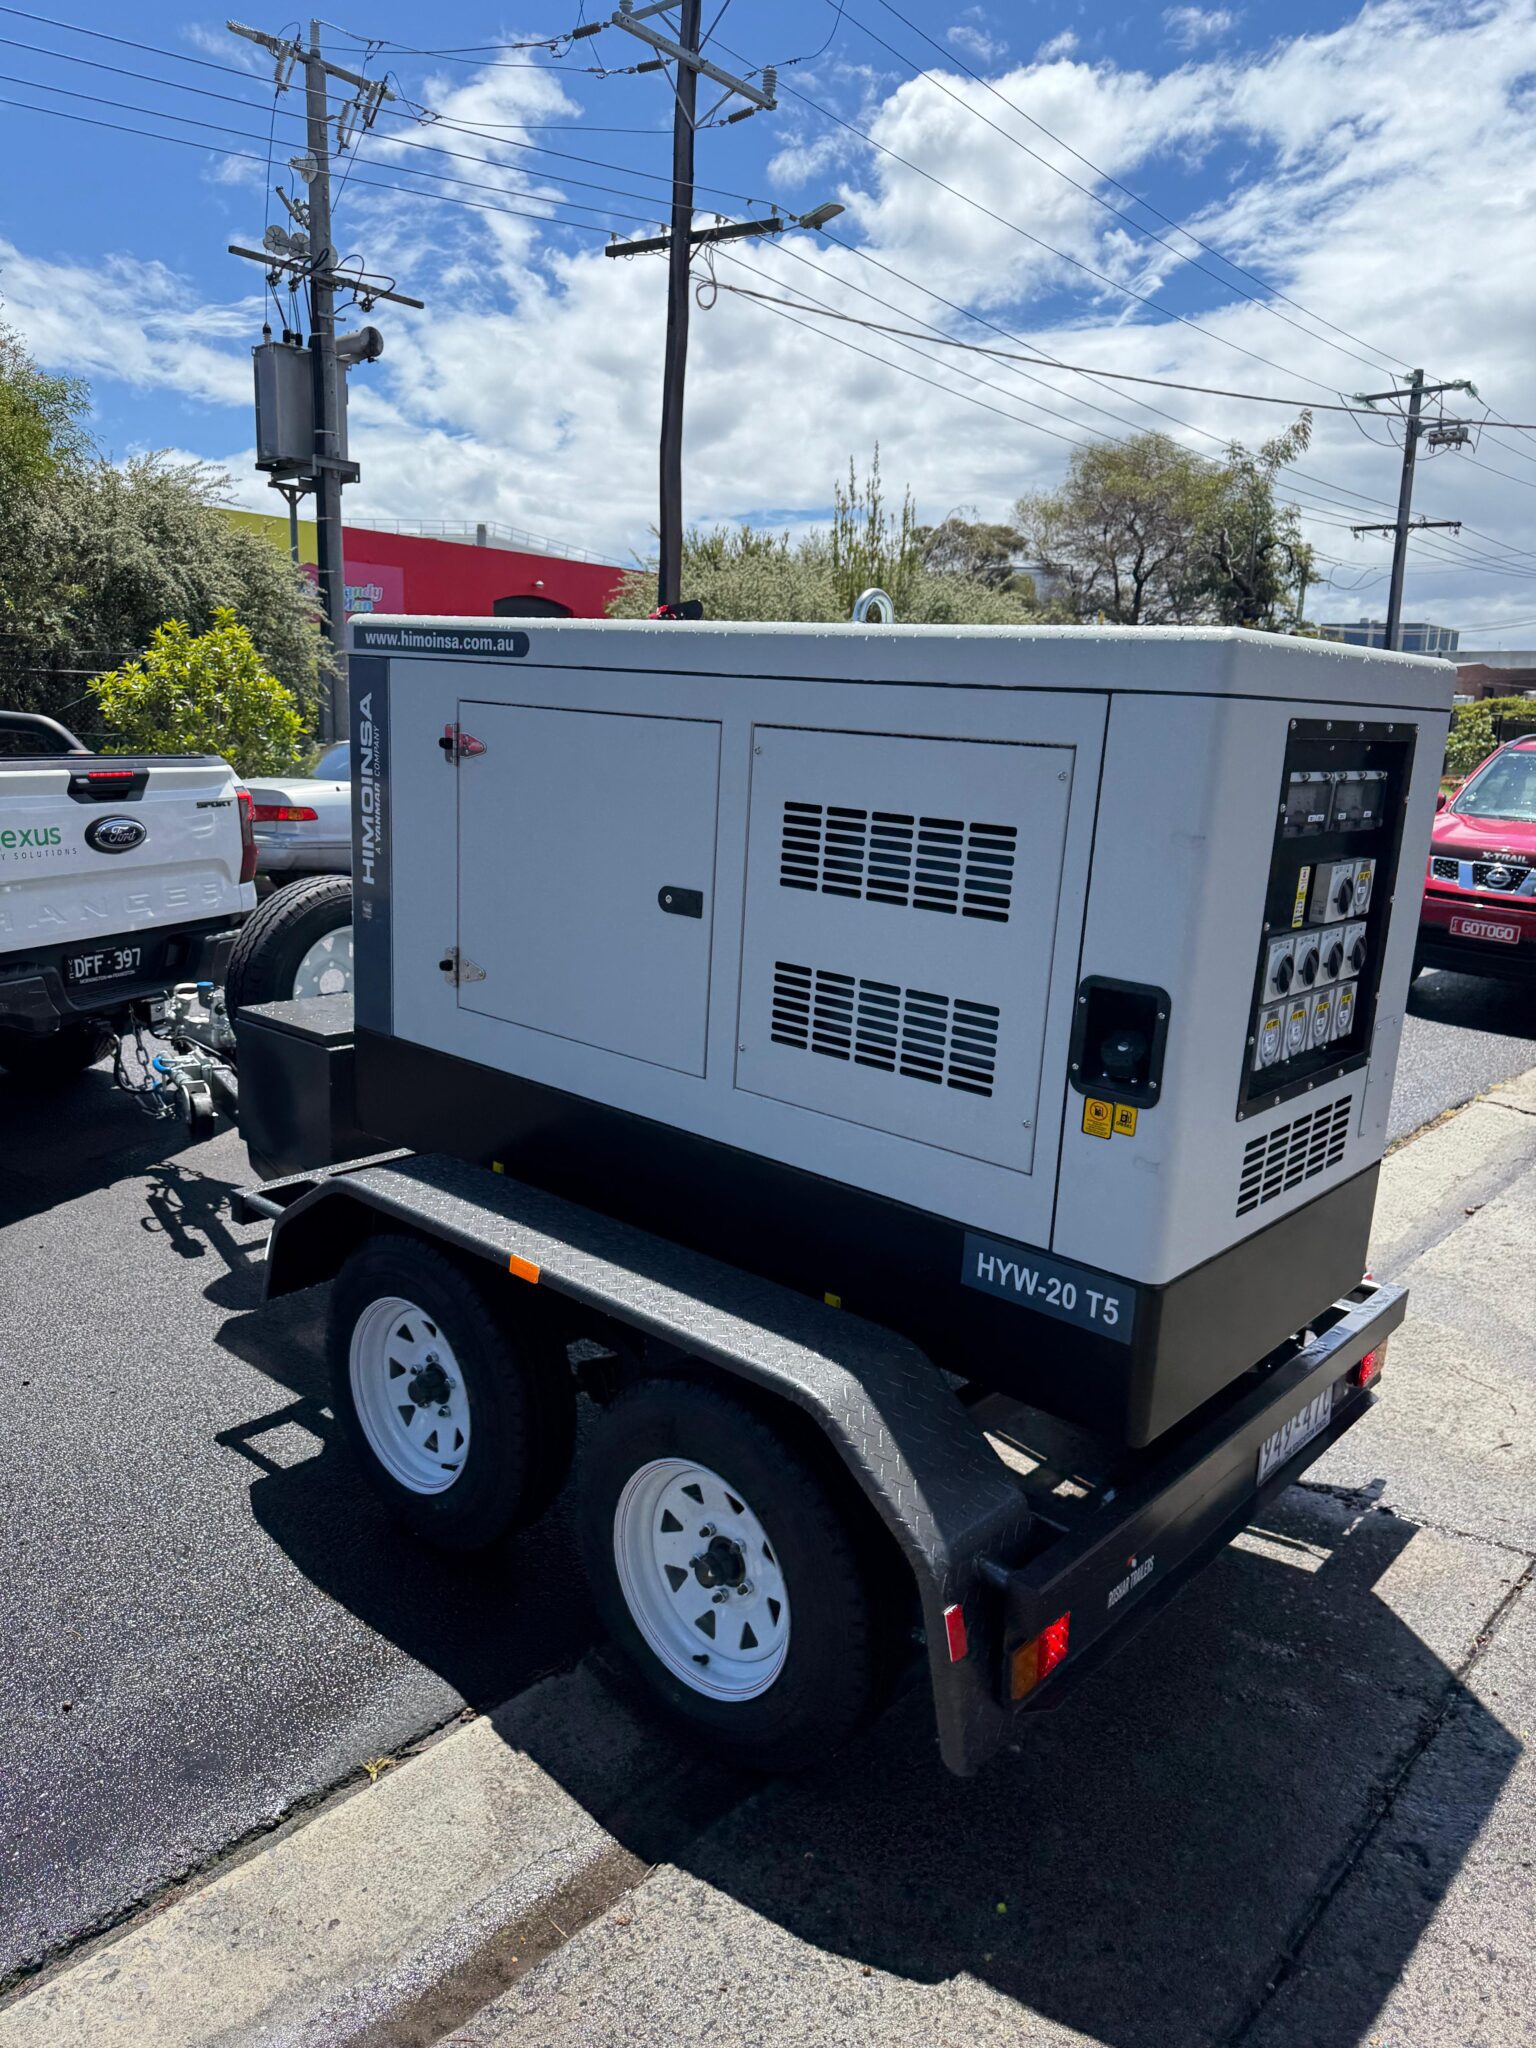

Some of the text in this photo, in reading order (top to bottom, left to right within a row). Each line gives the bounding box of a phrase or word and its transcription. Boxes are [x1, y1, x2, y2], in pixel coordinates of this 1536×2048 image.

[343, 584, 383, 602] andy
[365, 631, 514, 651] www.himoinsa.com.au
[360, 692, 375, 885] HIMOINSA
[196, 800, 232, 809] SPORT
[373, 783, 381, 843] YANMAR
[108, 825, 137, 842] Ford
[14, 848, 78, 860] SOLUTIONS
[1482, 851, 1528, 864] X-TRAIL
[1461, 921, 1514, 941] GOTOGO
[977, 1252, 1119, 1325] HYW-20 T5
